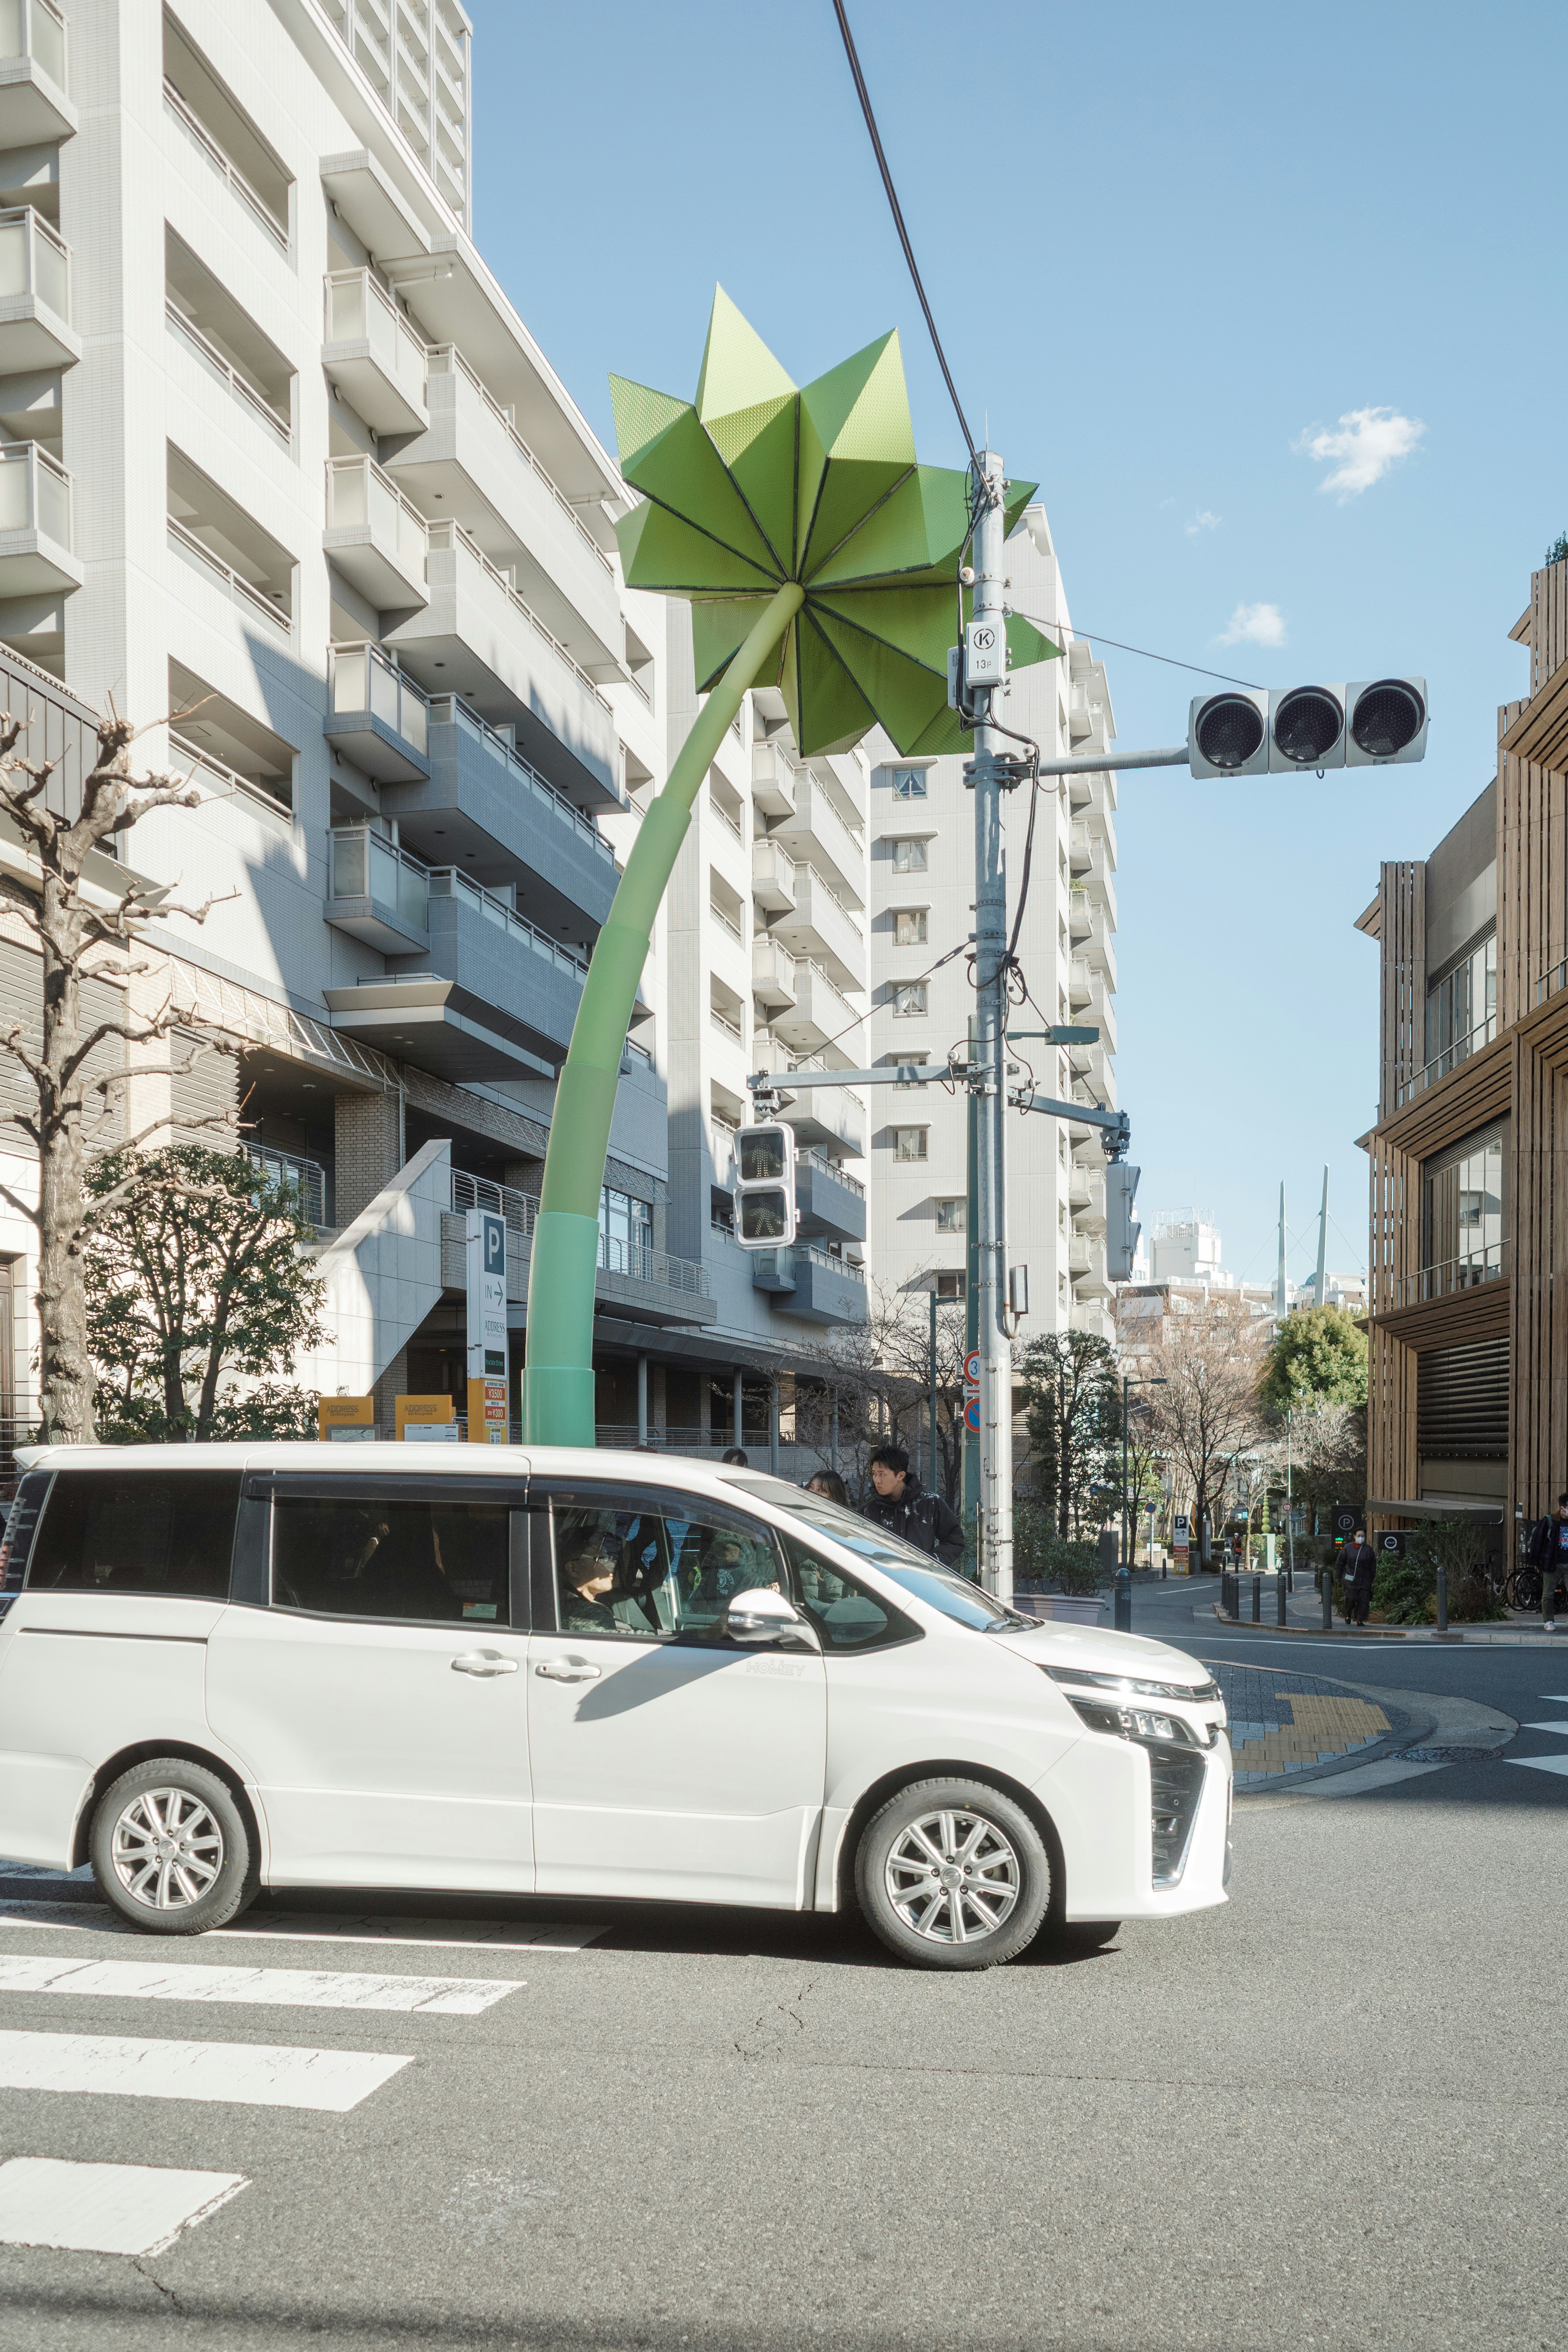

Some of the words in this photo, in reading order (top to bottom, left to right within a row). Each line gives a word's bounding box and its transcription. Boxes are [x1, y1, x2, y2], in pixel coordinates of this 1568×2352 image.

[489, 1225, 500, 1265] P
[485, 1284, 492, 1299] IN
[484, 1320, 505, 1333] ADDRESS
[970, 1360, 979, 1375] 3
[404, 1404, 437, 1412] ADDRESS
[1177, 1518, 1184, 1527] P
[1343, 1518, 1350, 1527] P
[746, 1659, 806, 1677] HOMEY
